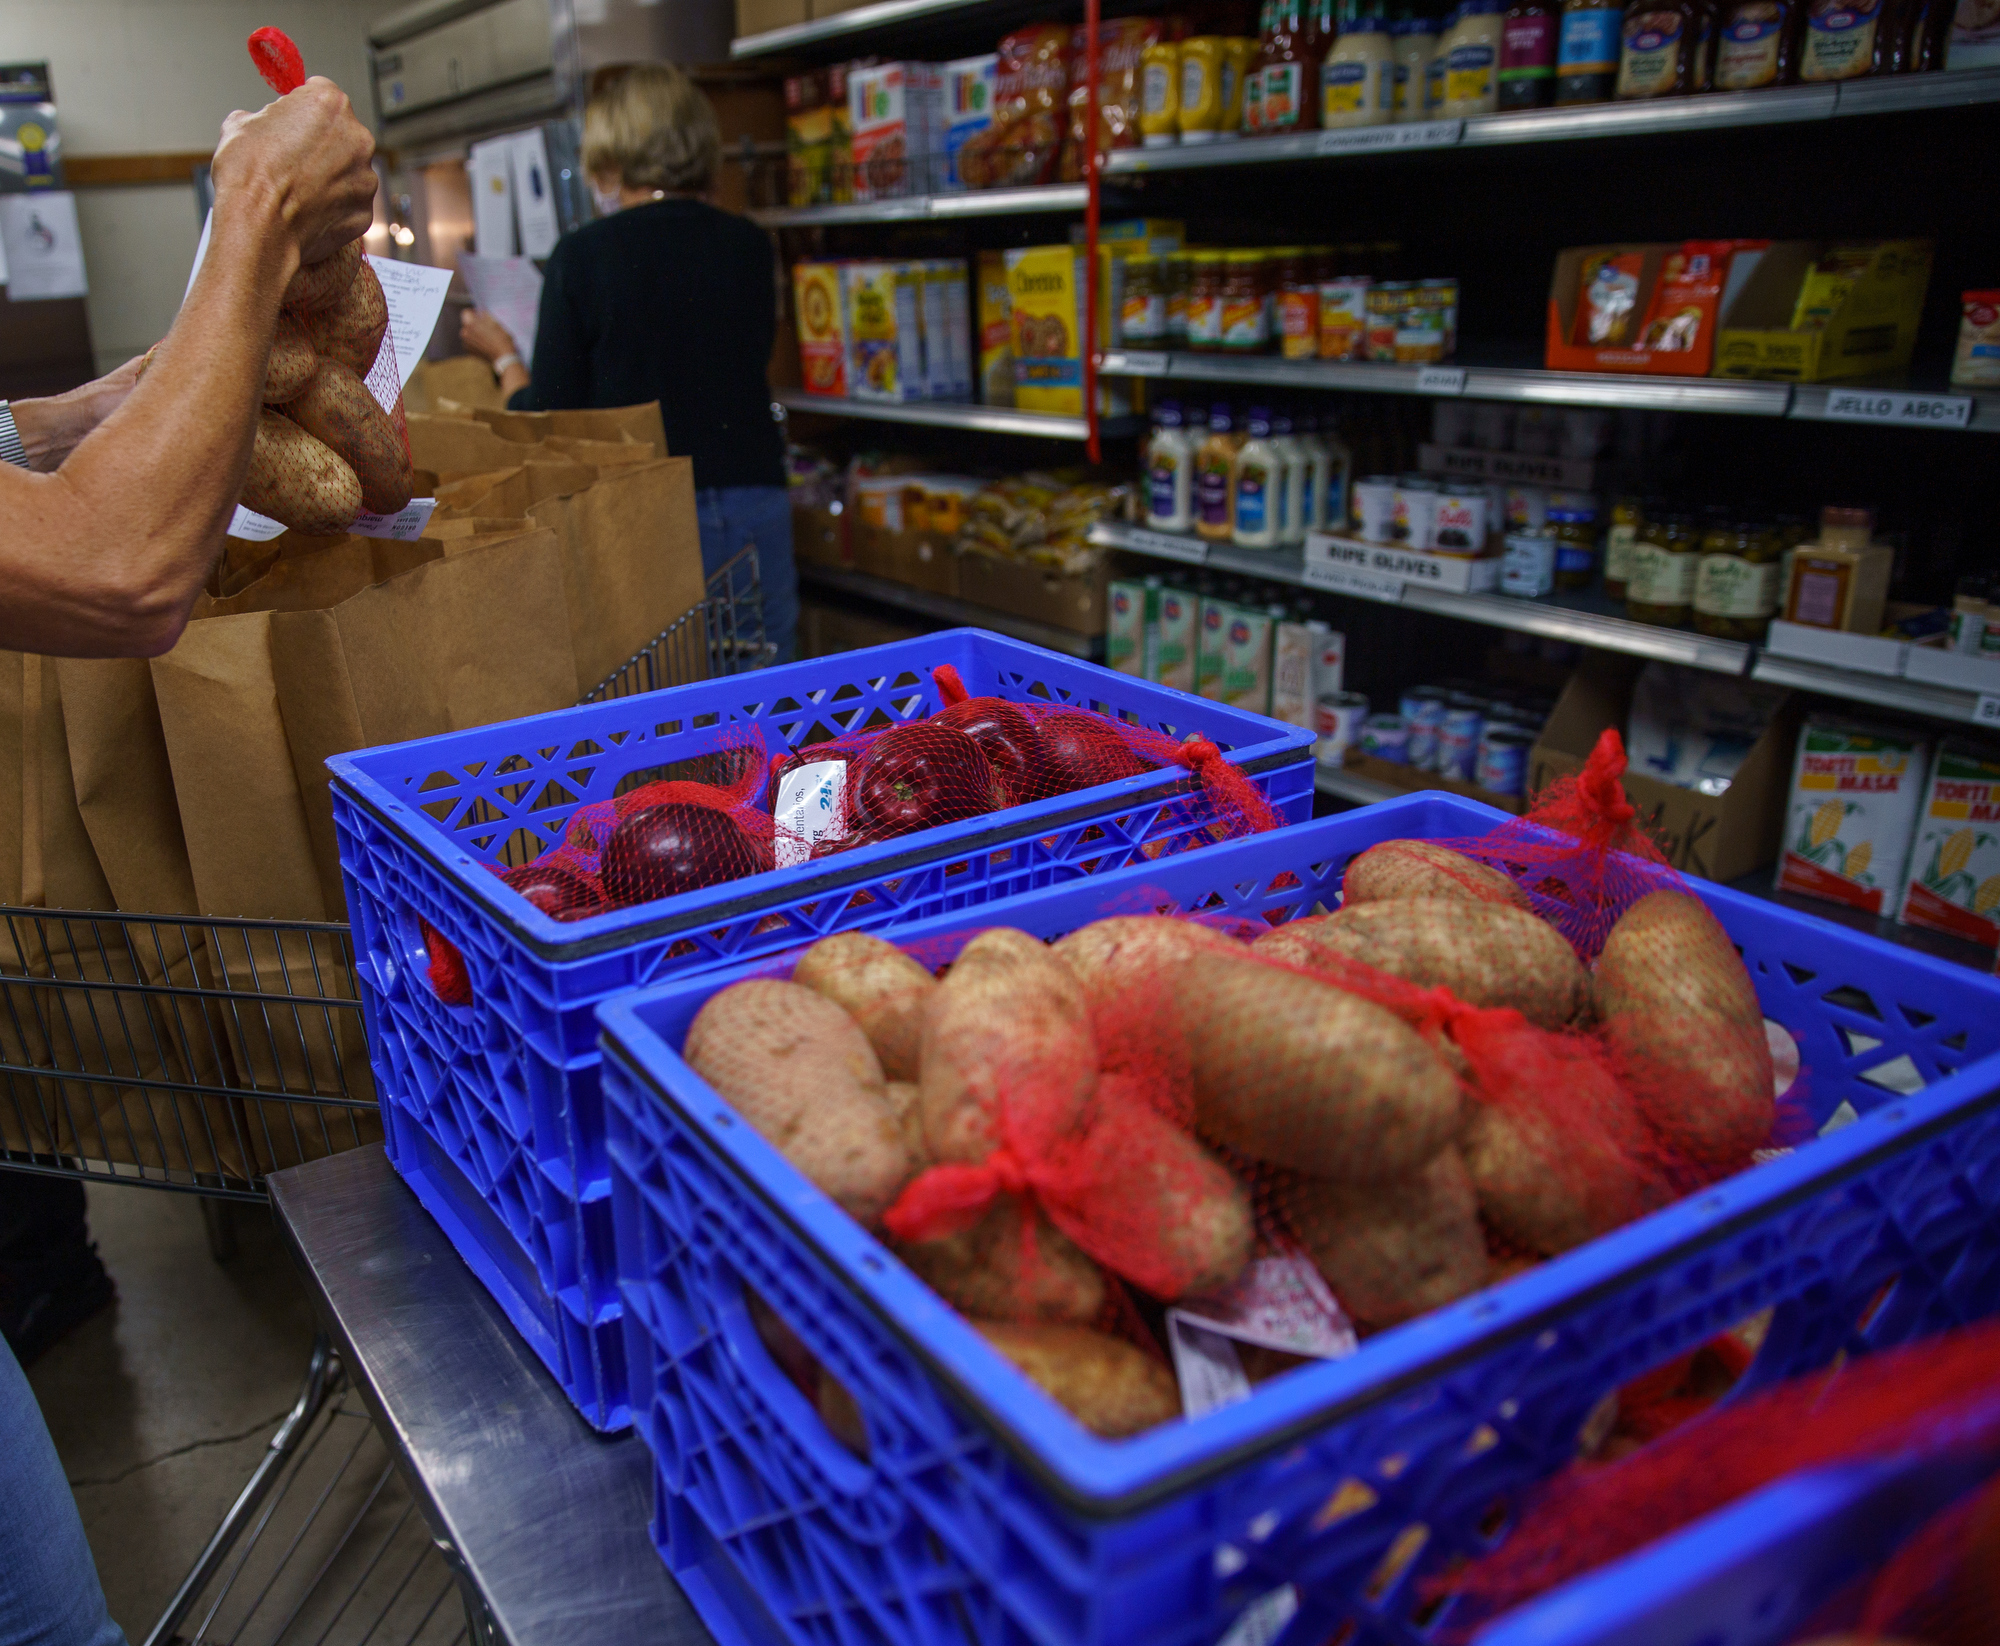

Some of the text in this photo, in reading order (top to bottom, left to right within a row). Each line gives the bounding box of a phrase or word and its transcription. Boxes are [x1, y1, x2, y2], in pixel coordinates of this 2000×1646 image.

[1832, 397, 1893, 416] JELLO
[1444, 453, 1563, 480] RIPE OLIVES
[1328, 543, 1442, 579] RIPE OLIVES
[1803, 753, 1856, 773] TORTI
[1838, 774, 1901, 792] MASA
[1935, 780, 1990, 801] TORTI
